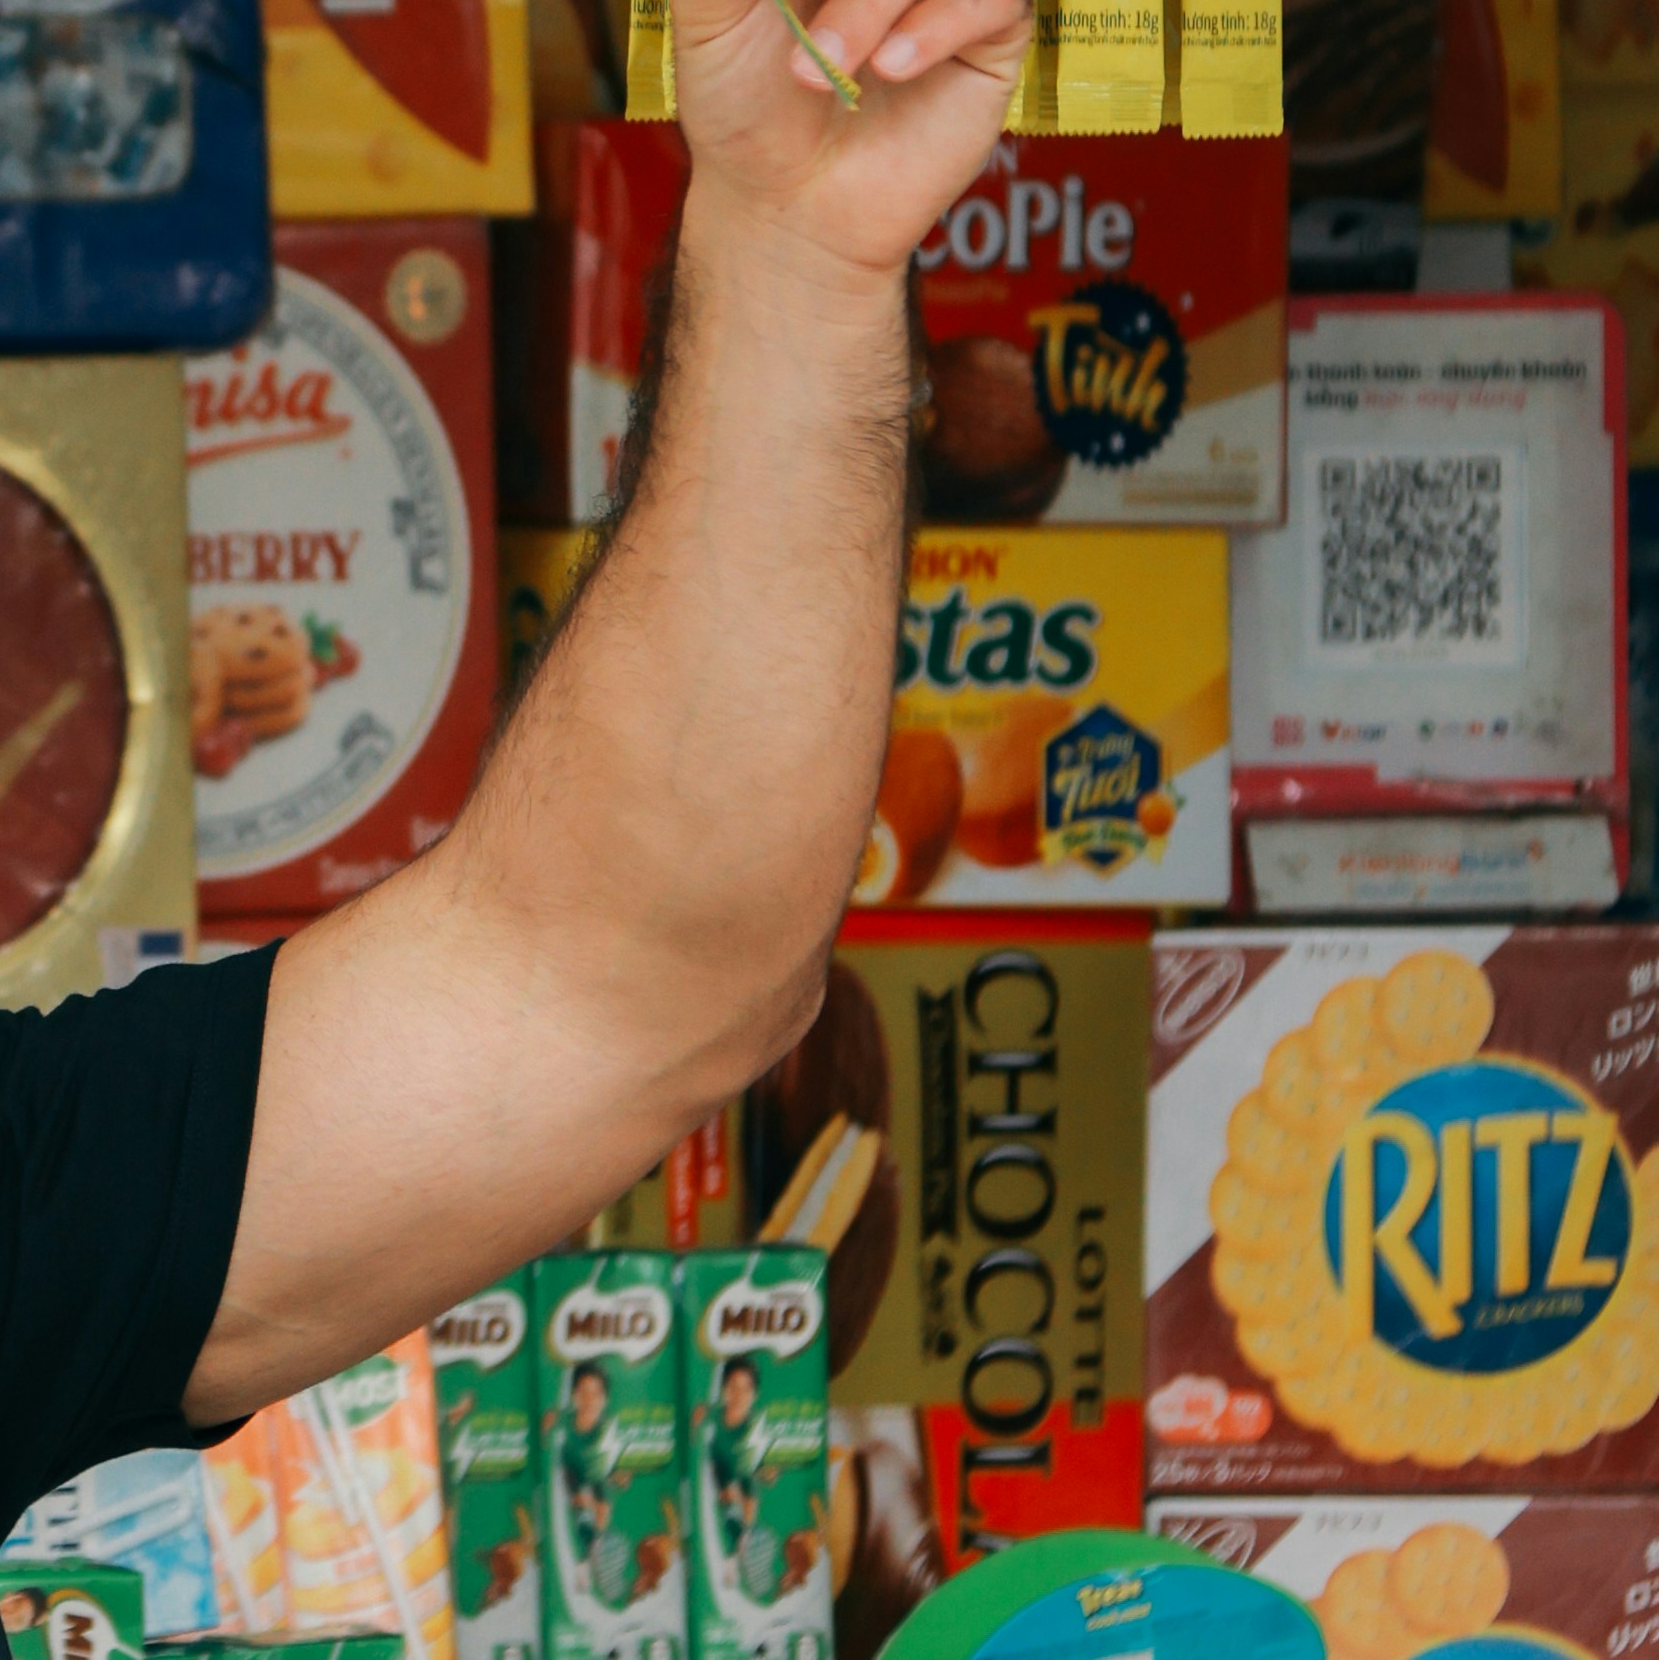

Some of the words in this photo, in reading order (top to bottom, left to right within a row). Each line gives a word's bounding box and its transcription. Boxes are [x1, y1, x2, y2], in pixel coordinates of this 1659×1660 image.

[1135, 9, 1161, 35] 18g
[1253, 11, 1278, 36] 18g
[186, 530, 361, 585] BERRY
[1342, 1110, 1619, 1340] RITZ
[565, 1308, 657, 1339] MILO
[719, 1303, 808, 1336] MILO
[1072, 1204, 1107, 1429] LOTTE
[1471, 1291, 1586, 1331] CRACKERS
[433, 1313, 511, 1344] MILO
